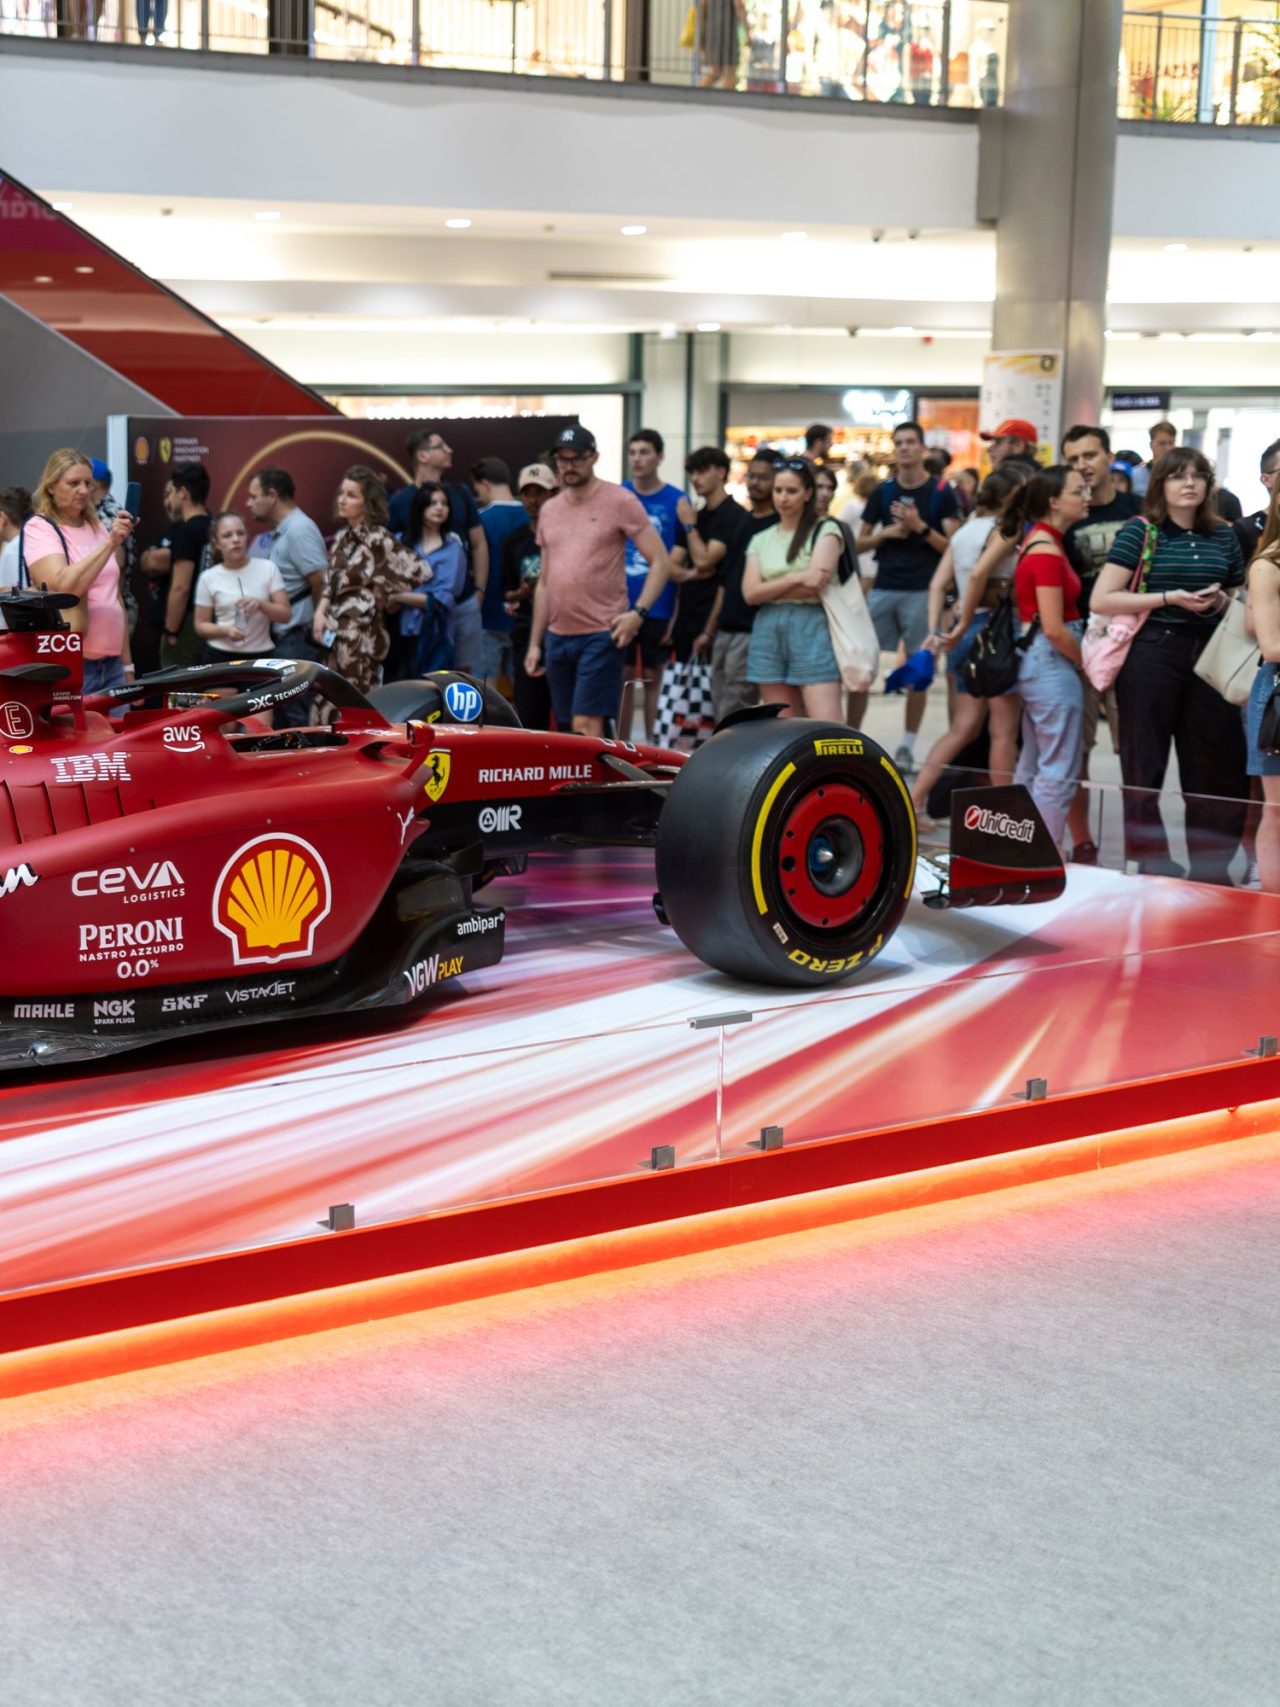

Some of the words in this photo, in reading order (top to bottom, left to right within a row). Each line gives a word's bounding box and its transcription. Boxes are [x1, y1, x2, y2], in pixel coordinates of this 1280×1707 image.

[247, 693, 274, 712] DXC
[274, 681, 310, 702] TECHNOLOGY
[451, 682, 478, 721] hp
[4, 704, 27, 736] E
[162, 725, 202, 743] aws
[813, 738, 865, 756] PIRELLI
[49, 752, 131, 782] IBM
[478, 766, 545, 783] RICHARD
[548, 764, 593, 780] MILLE
[979, 810, 1035, 842] UniCredit
[123, 888, 186, 904] LOGISTICS
[78, 916, 184, 951] PERONI
[79, 949, 127, 962] NASTRO
[129, 942, 185, 957] AZZURRO
[868, 933, 884, 957] P
[116, 958, 159, 979] 0.0%
[787, 948, 865, 974] ZERO
[403, 953, 440, 997] VGW
[438, 956, 464, 980] PLAY
[13, 1003, 76, 1018] MAHLE
[93, 999, 136, 1018] NGK
[161, 994, 209, 1012] SKF
[94, 1017, 115, 1025] SPARK
[115, 1017, 136, 1025] PLUGS
